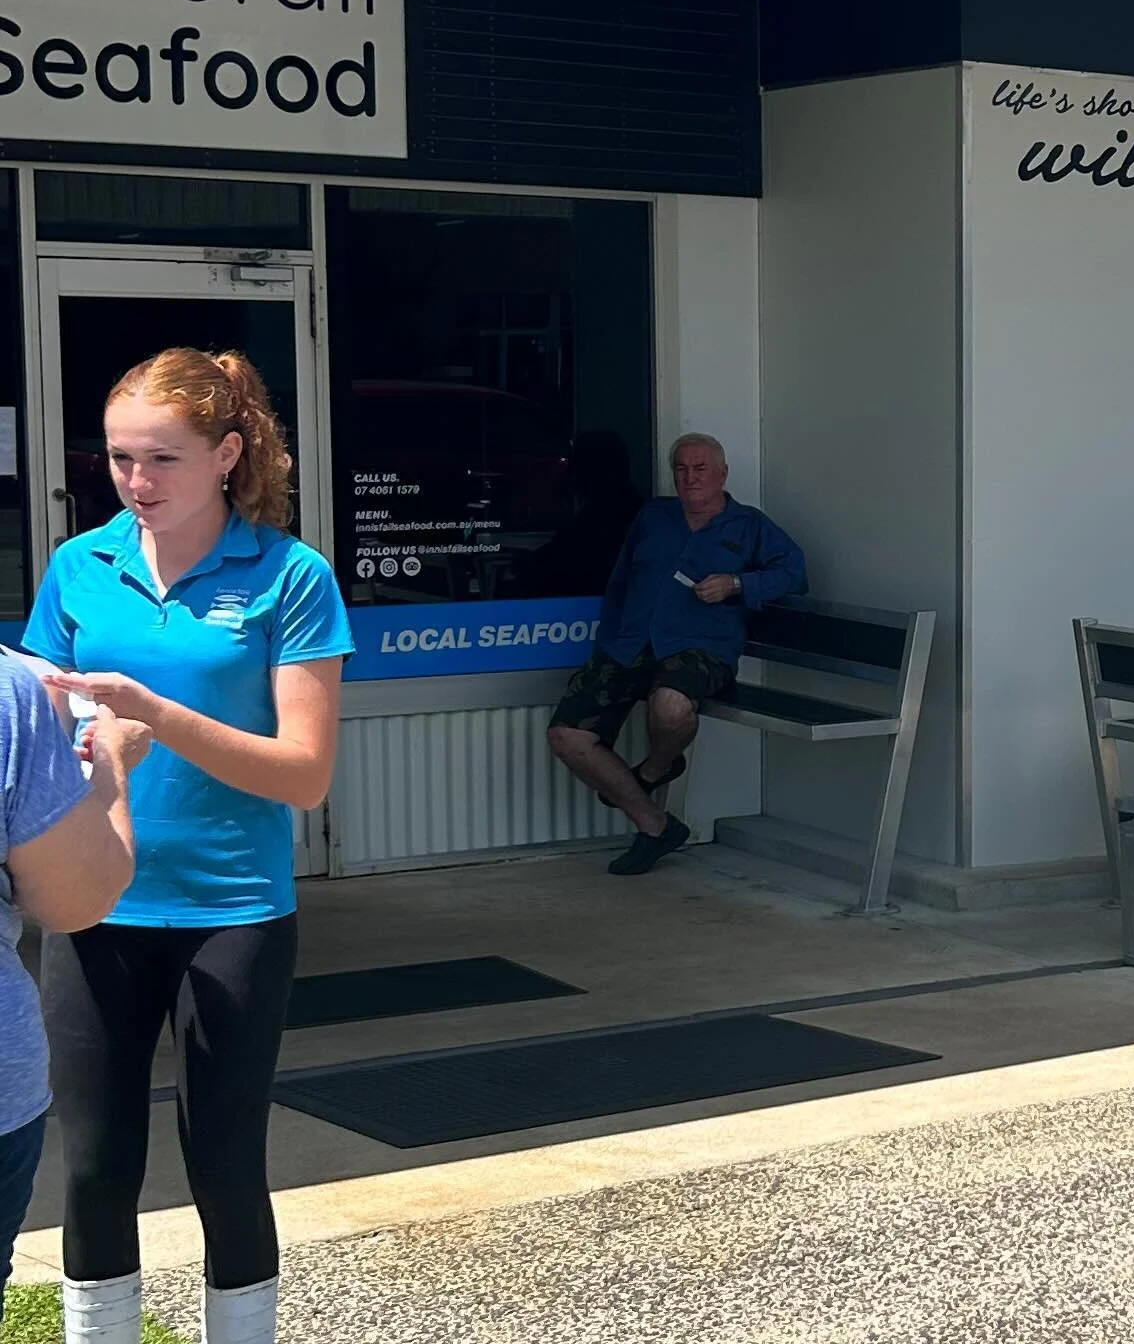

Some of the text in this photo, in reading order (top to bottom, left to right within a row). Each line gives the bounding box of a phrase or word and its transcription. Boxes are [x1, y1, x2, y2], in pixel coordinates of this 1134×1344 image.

[992, 79, 1075, 115] life's
[354, 474, 381, 483] CALL
[354, 486, 368, 495] 07
[356, 546, 401, 556] FOLLOW
[401, 545, 417, 555] US
[380, 627, 472, 653] LOCAL
